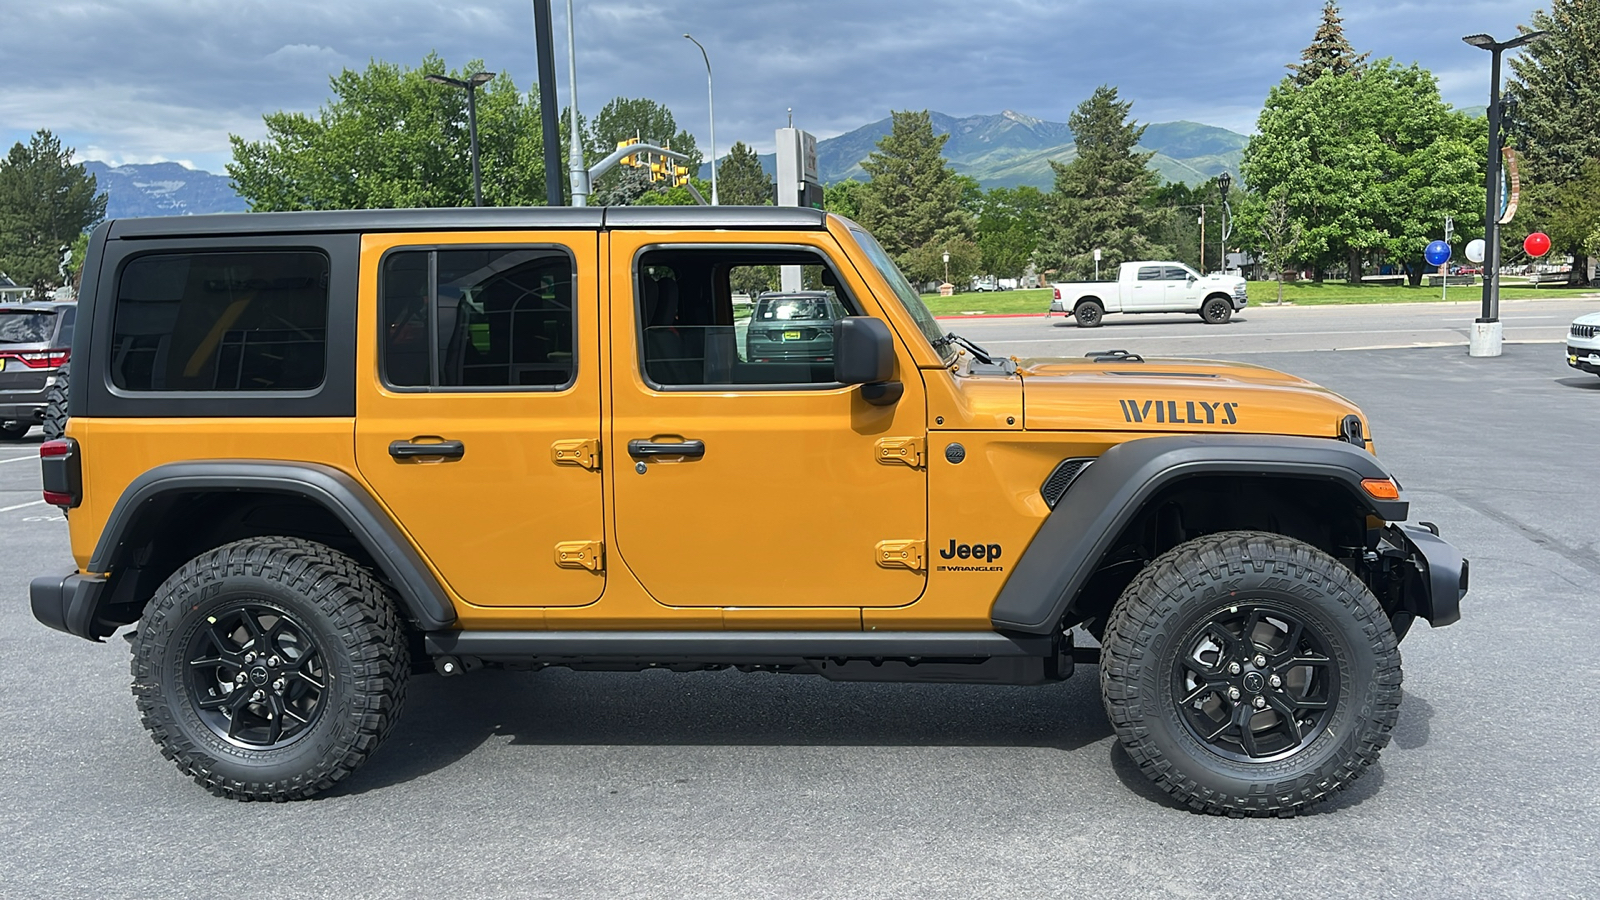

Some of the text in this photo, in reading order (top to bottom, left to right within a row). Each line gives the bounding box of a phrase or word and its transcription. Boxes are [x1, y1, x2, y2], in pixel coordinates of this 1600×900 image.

[1119, 400, 1238, 424] WILLYS
[939, 538, 1002, 563] Jeep
[1142, 576, 1324, 717] WILDPEAK M/T
